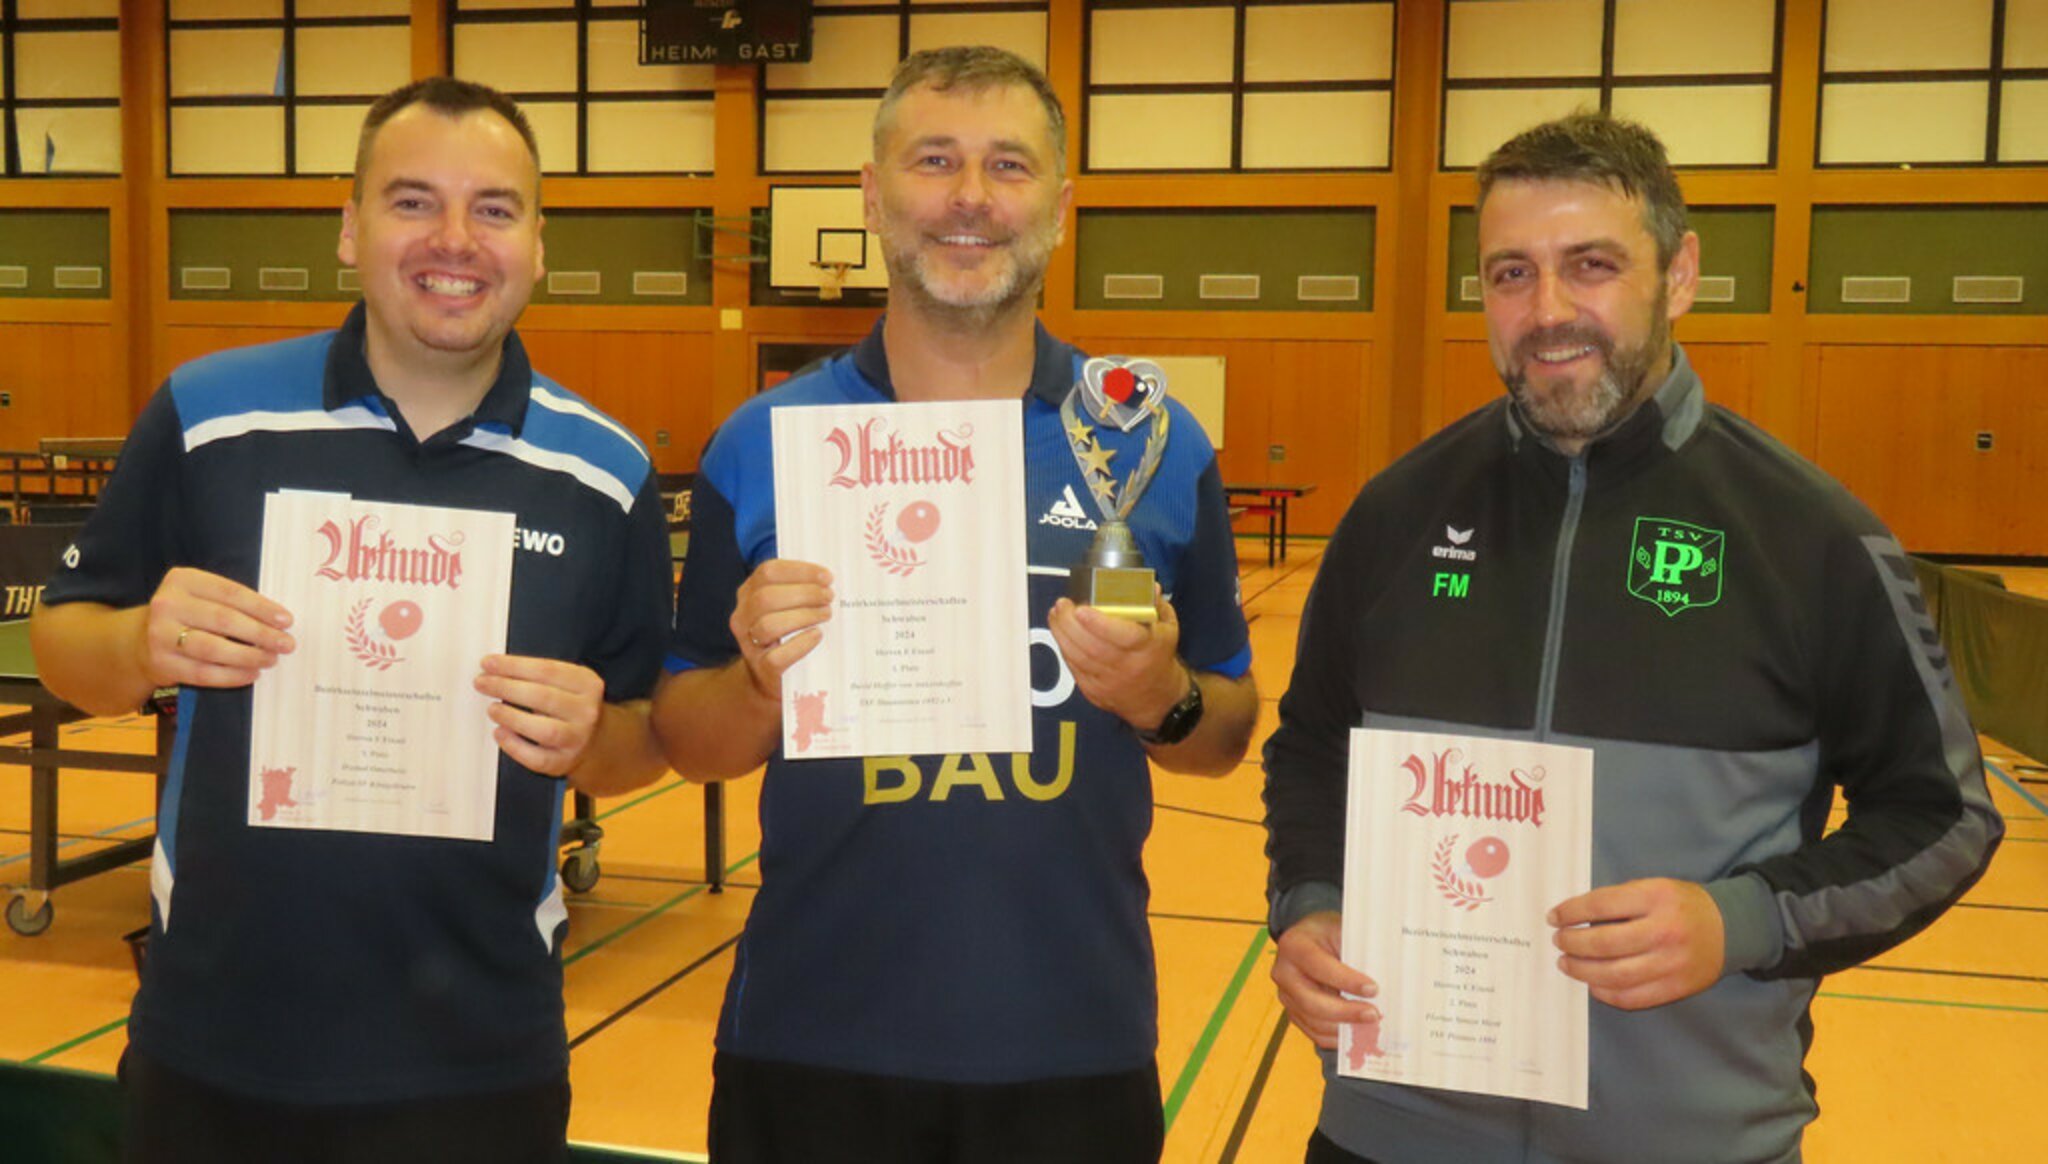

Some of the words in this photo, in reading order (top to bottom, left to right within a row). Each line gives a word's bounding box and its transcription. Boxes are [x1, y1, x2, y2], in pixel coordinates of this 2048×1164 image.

[652, 44, 712, 61] HEIM
[738, 43, 800, 60] GAST
[825, 416, 976, 489] Urkunde
[1038, 513, 1099, 531] JOOLA
[1658, 527, 1702, 541] TSV
[315, 514, 465, 590] Urkunde
[1432, 545, 1477, 561] erima
[1433, 573, 1470, 598] FM
[1657, 589, 1690, 605] 1894
[863, 721, 1077, 805] BAU
[1401, 748, 1546, 828] Urkunde
